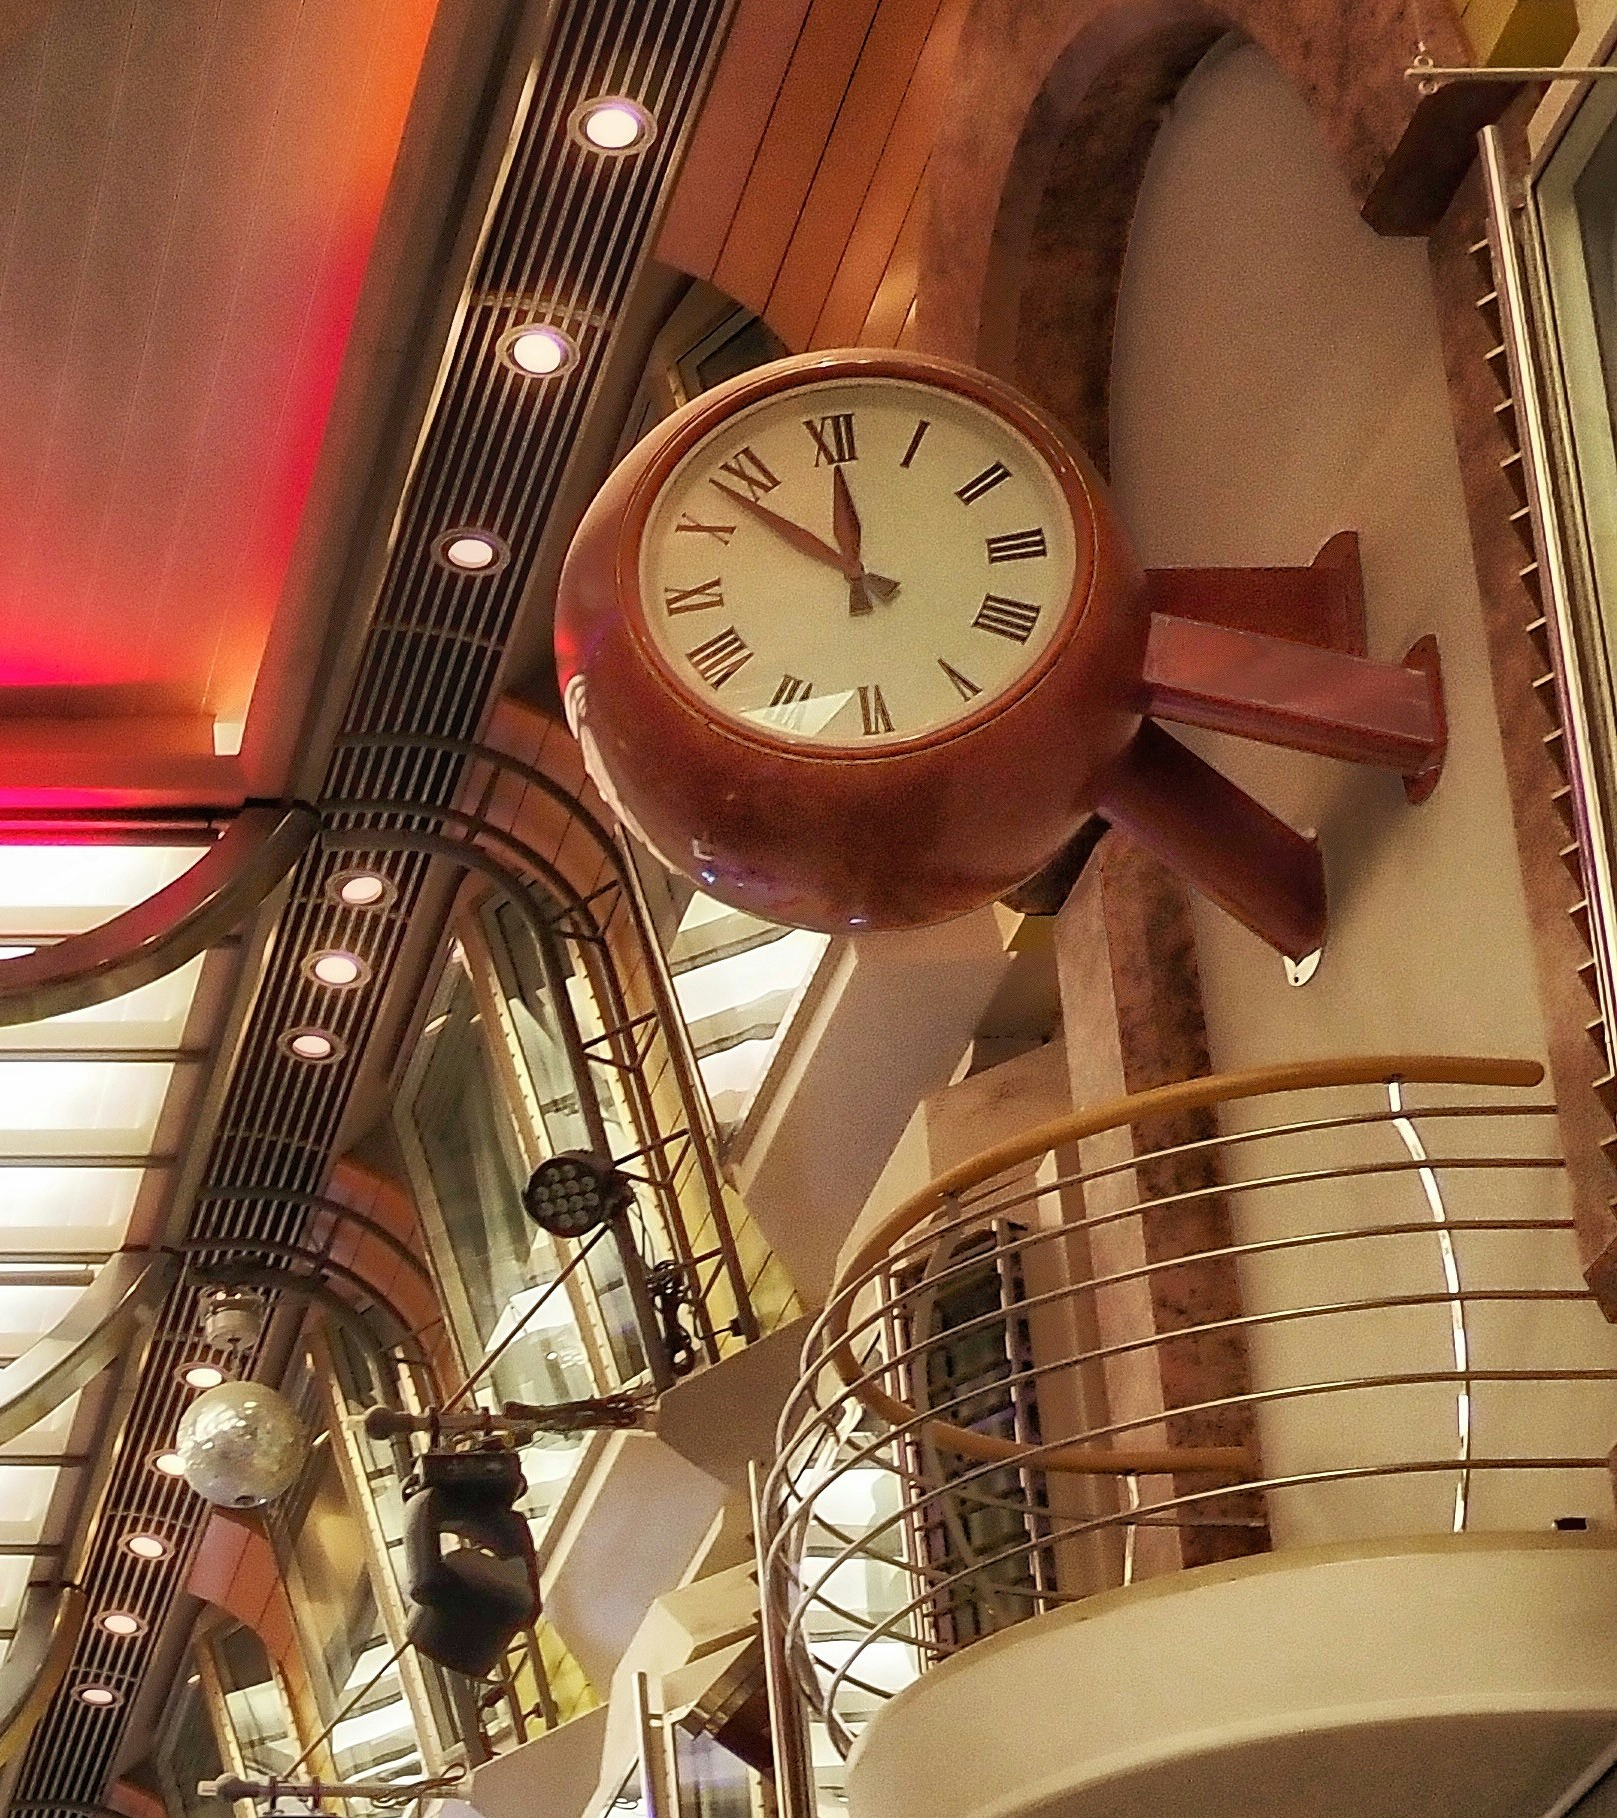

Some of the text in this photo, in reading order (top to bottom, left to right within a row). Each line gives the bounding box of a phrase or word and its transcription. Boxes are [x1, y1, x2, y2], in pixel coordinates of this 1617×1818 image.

[802, 412, 858, 467] XII
[719, 447, 781, 503] XI
[954, 461, 1013, 506] II
[675, 512, 737, 546] X
[985, 527, 1047, 565] III
[664, 577, 724, 617] IX
